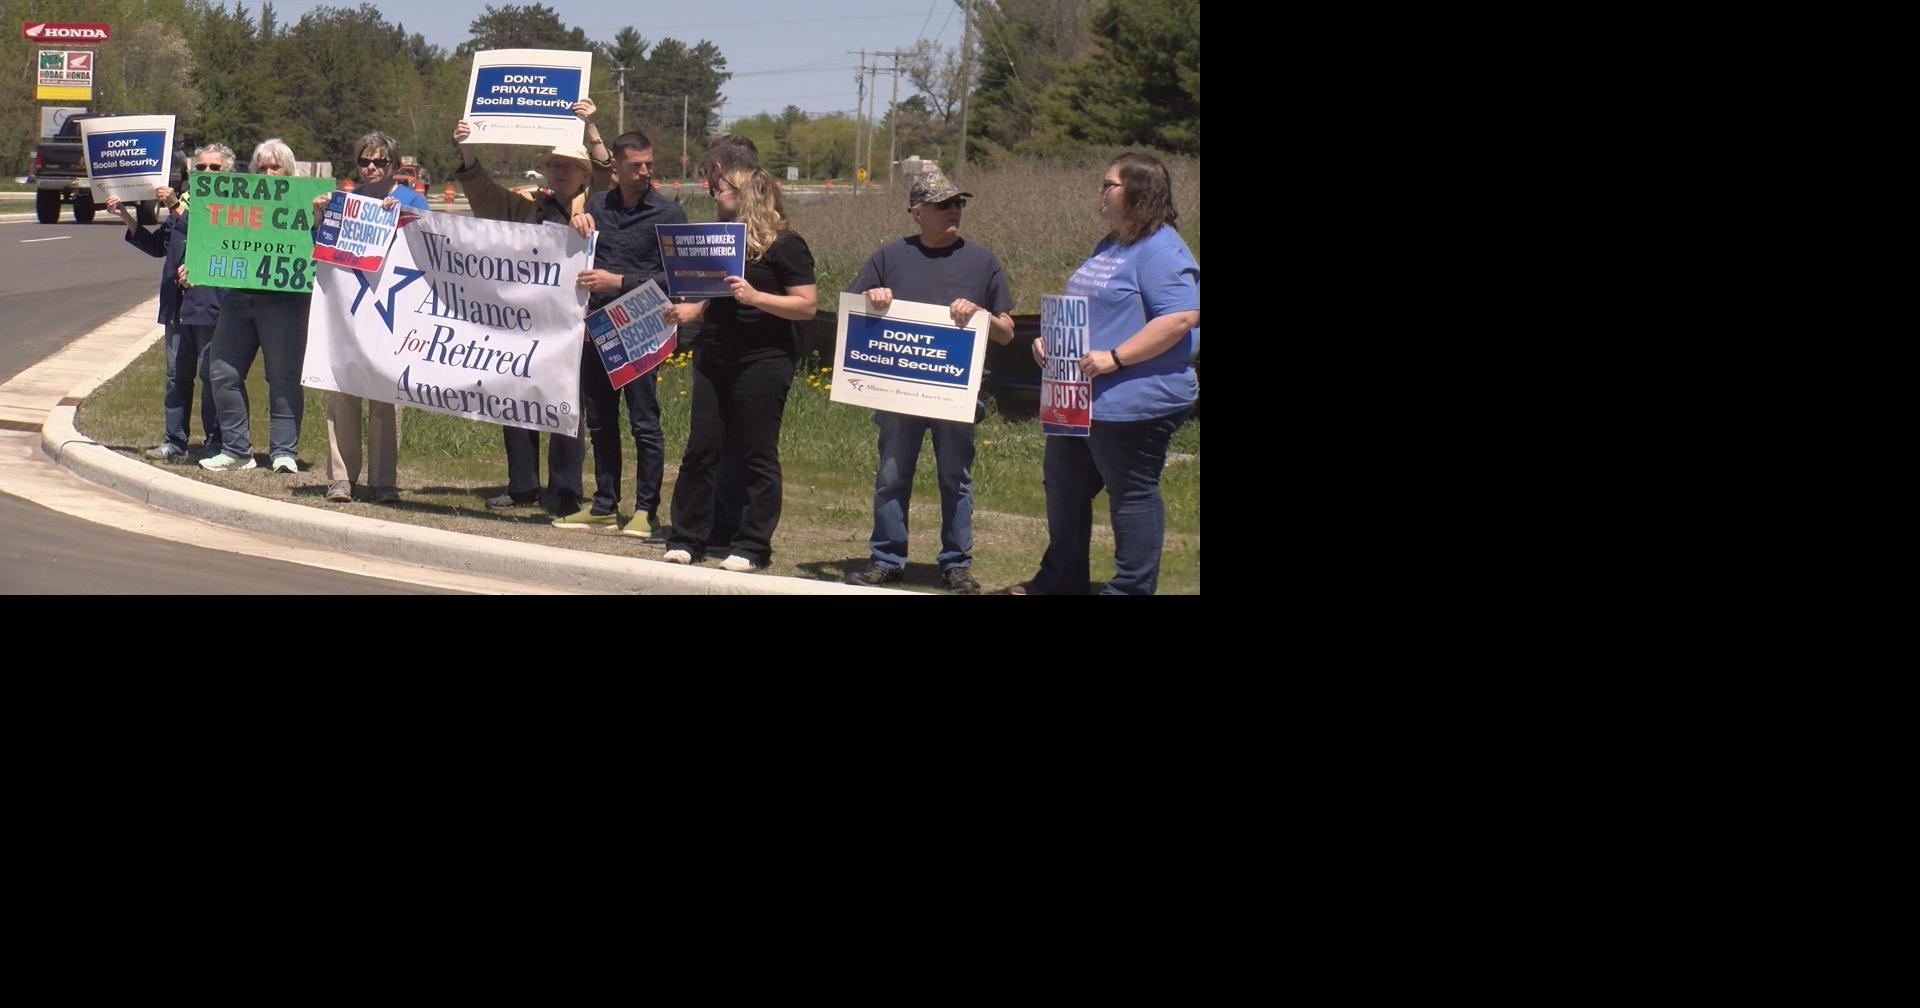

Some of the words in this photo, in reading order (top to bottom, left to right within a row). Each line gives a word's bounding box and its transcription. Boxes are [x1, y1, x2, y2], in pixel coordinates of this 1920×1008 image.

[44, 28, 108, 38] HONDA
[66, 71, 91, 80] HONDA
[503, 74, 547, 84] DON'T
[491, 86, 558, 96] PRIVATIZE
[476, 97, 513, 106] Social
[517, 97, 573, 109] Security
[100, 147, 147, 159] PRIVATIZE
[107, 138, 139, 149] DON'T
[92, 160, 118, 170] Social
[119, 157, 159, 168] Security
[195, 175, 290, 201] SCRAP
[208, 203, 265, 228] THE
[272, 207, 315, 231] CA
[345, 198, 361, 219] NO
[341, 219, 391, 247] SECURITY
[706, 234, 736, 245] WORKERS
[221, 239, 297, 255] SUPPORT
[709, 246, 736, 257] AMERICA
[208, 255, 249, 279] HR
[420, 230, 561, 287] Wisconsin
[414, 278, 532, 332] Alliance
[608, 304, 631, 329] NO
[620, 306, 669, 350] SECURIT
[883, 329, 935, 344] DON'T
[394, 328, 430, 356] for
[422, 323, 540, 379] Retired
[868, 339, 948, 360] PRIVATIZE
[850, 350, 894, 366] Social
[897, 358, 965, 377] Security
[1054, 384, 1088, 410] CUTS
